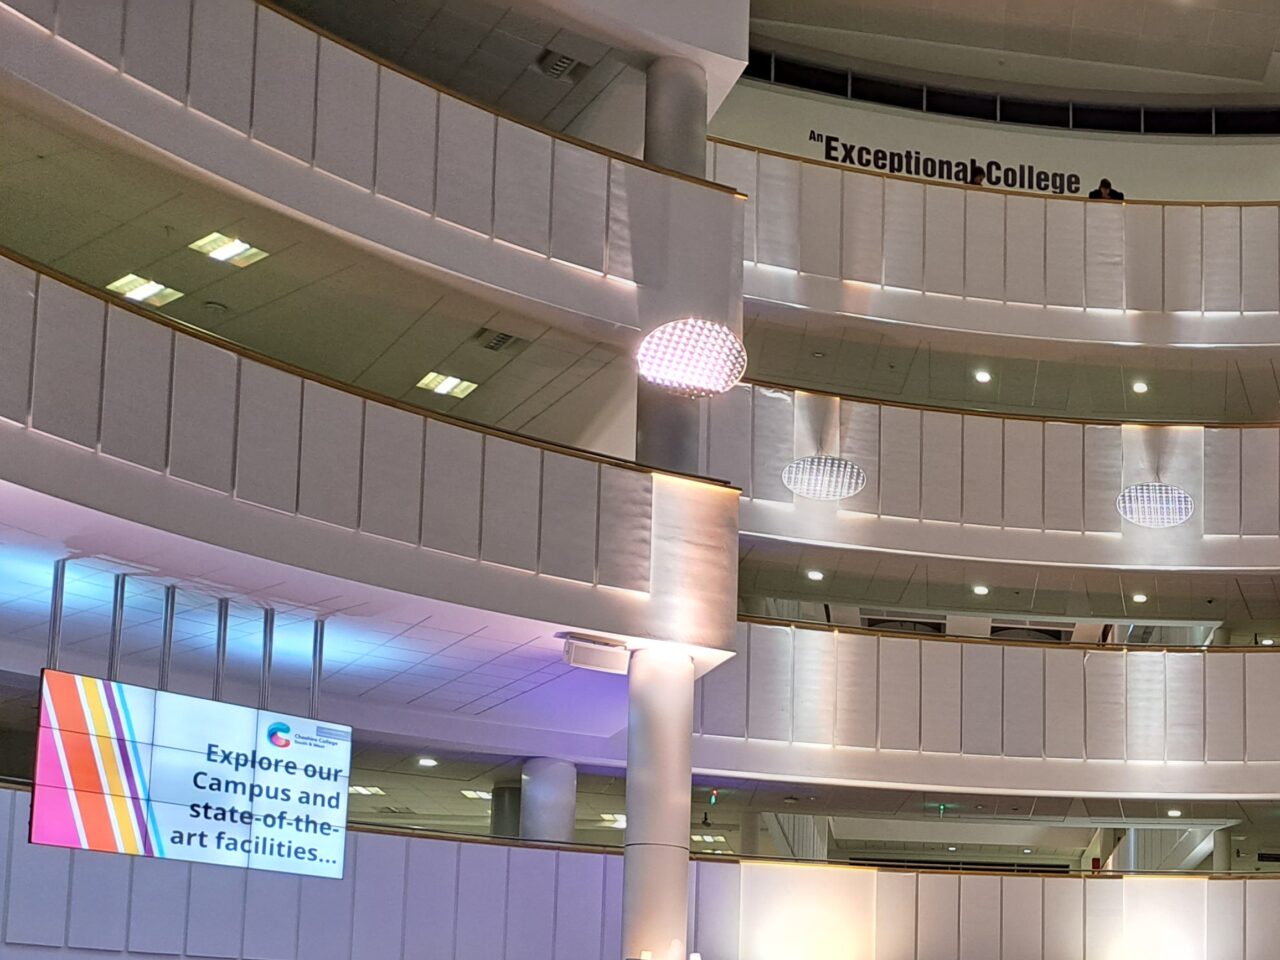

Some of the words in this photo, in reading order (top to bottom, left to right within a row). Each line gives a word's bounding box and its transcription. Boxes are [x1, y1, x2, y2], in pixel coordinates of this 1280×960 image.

[808, 130, 824, 143] An
[824, 135, 977, 184] Exceptional
[986, 160, 1080, 195] College
[207, 743, 297, 775] Explore
[303, 763, 343, 782] our
[193, 771, 291, 802] Campus
[298, 790, 340, 810] and
[189, 802, 339, 836] state-of-the-
[170, 829, 208, 849] art
[216, 831, 337, 864] facilities...
